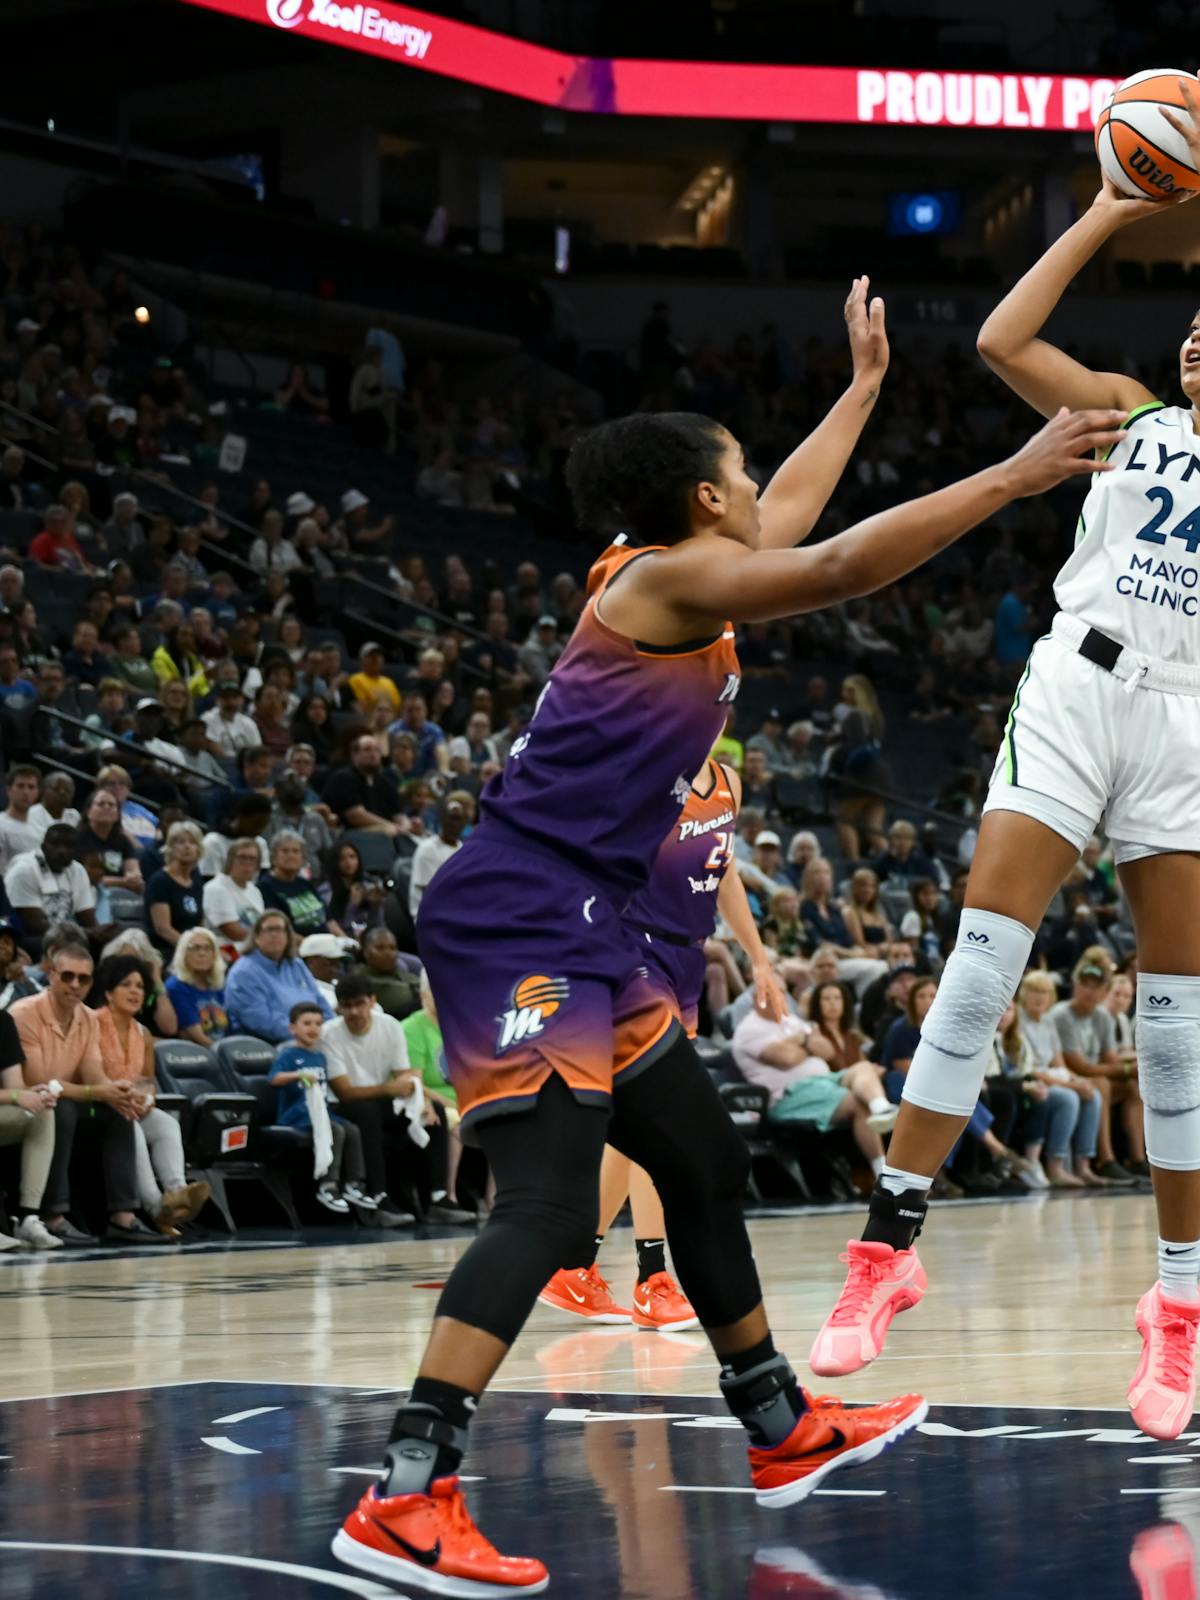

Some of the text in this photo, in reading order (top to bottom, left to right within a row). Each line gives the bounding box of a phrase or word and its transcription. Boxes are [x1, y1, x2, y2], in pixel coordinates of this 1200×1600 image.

[363, 7, 432, 58] Energy
[857, 71, 1053, 128] PROUDLY
[1129, 553, 1199, 589] MAYO
[1116, 575, 1199, 617] CLINIC
